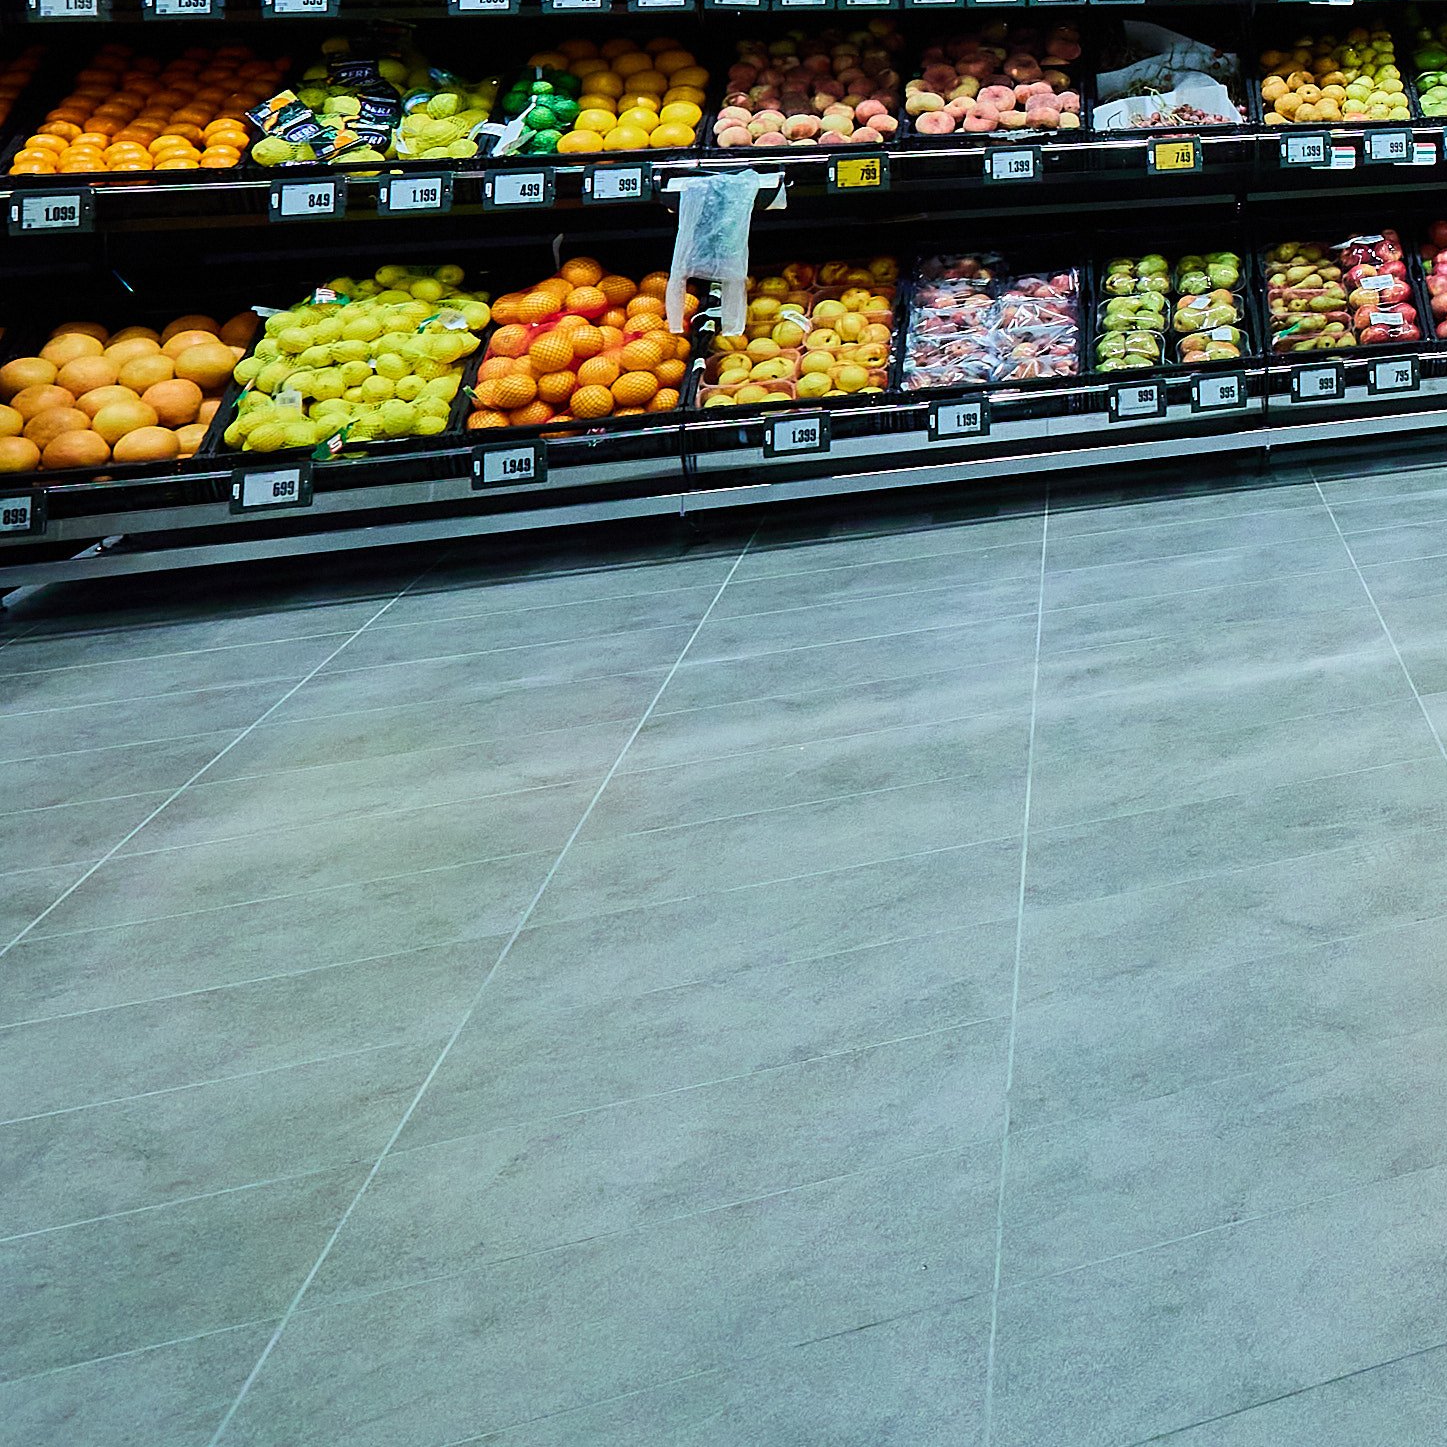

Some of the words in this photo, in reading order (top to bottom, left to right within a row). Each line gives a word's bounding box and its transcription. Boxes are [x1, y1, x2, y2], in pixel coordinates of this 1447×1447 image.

[289, 126, 316, 141] BERI
[1301, 144, 1321, 157] 1.399
[1389, 142, 1404, 154] 999
[1008, 160, 1030, 172] 1.399
[860, 168, 877, 180] 799
[519, 183, 540, 197] 499
[618, 178, 637, 191] 999
[308, 193, 330, 207] 849
[412, 188, 437, 202] 1.199
[45, 206, 75, 222] 1.099
[1319, 377, 1334, 389] 999
[1138, 388, 1154, 401] 999
[1219, 385, 1235, 398] 995
[956, 413, 978, 426] 1.199
[792, 428, 816, 443] 1.399
[502, 457, 531, 473] 1.949
[272, 480, 295, 497] 699
[2, 508, 27, 525] 899
